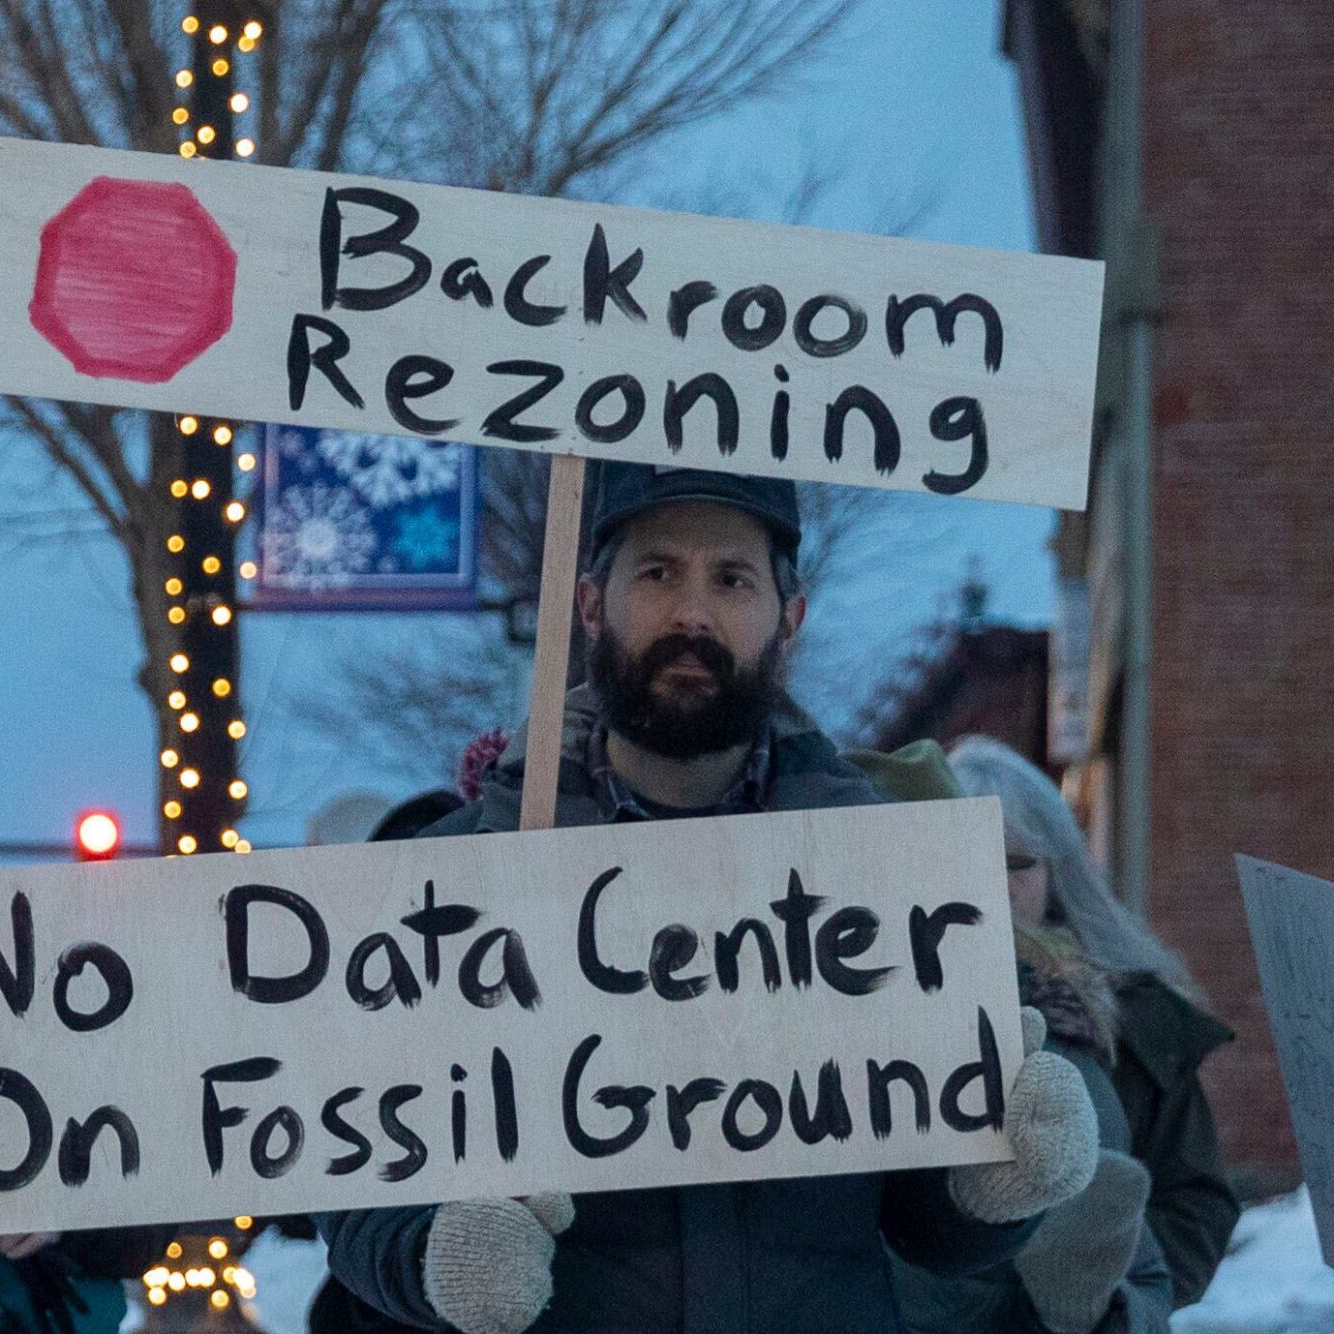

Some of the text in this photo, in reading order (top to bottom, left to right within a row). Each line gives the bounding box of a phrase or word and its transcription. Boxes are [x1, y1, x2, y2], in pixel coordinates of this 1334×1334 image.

[320, 185, 1004, 374] Backroom
[287, 312, 991, 495] Rezoning
[219, 879, 542, 1013] Data
[577, 866, 983, 1000] Center
[201, 1046, 519, 1182] Fossil
[562, 1005, 1007, 1160] Ground
